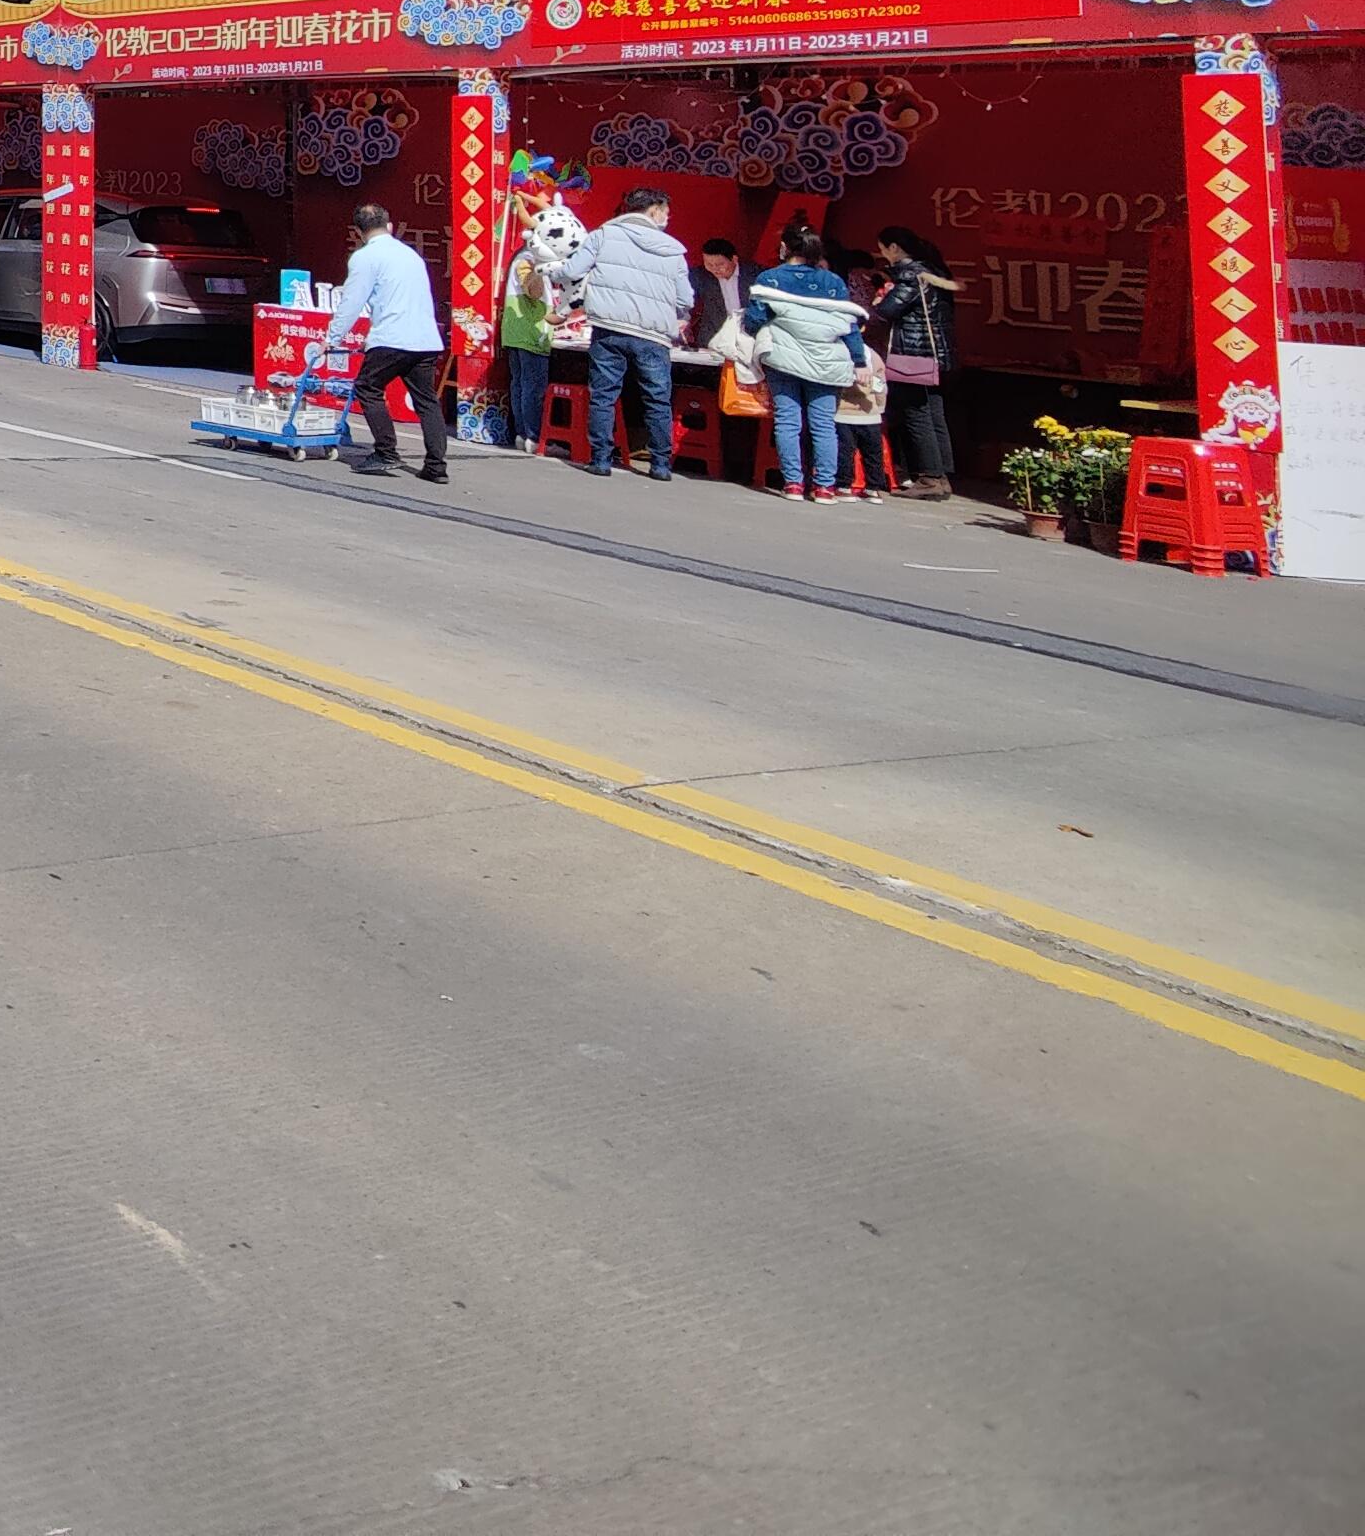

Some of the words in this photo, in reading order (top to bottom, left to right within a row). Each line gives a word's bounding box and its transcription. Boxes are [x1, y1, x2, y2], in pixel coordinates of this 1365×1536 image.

[104, 8, 393, 58] 伦教2023新年迎春花市
